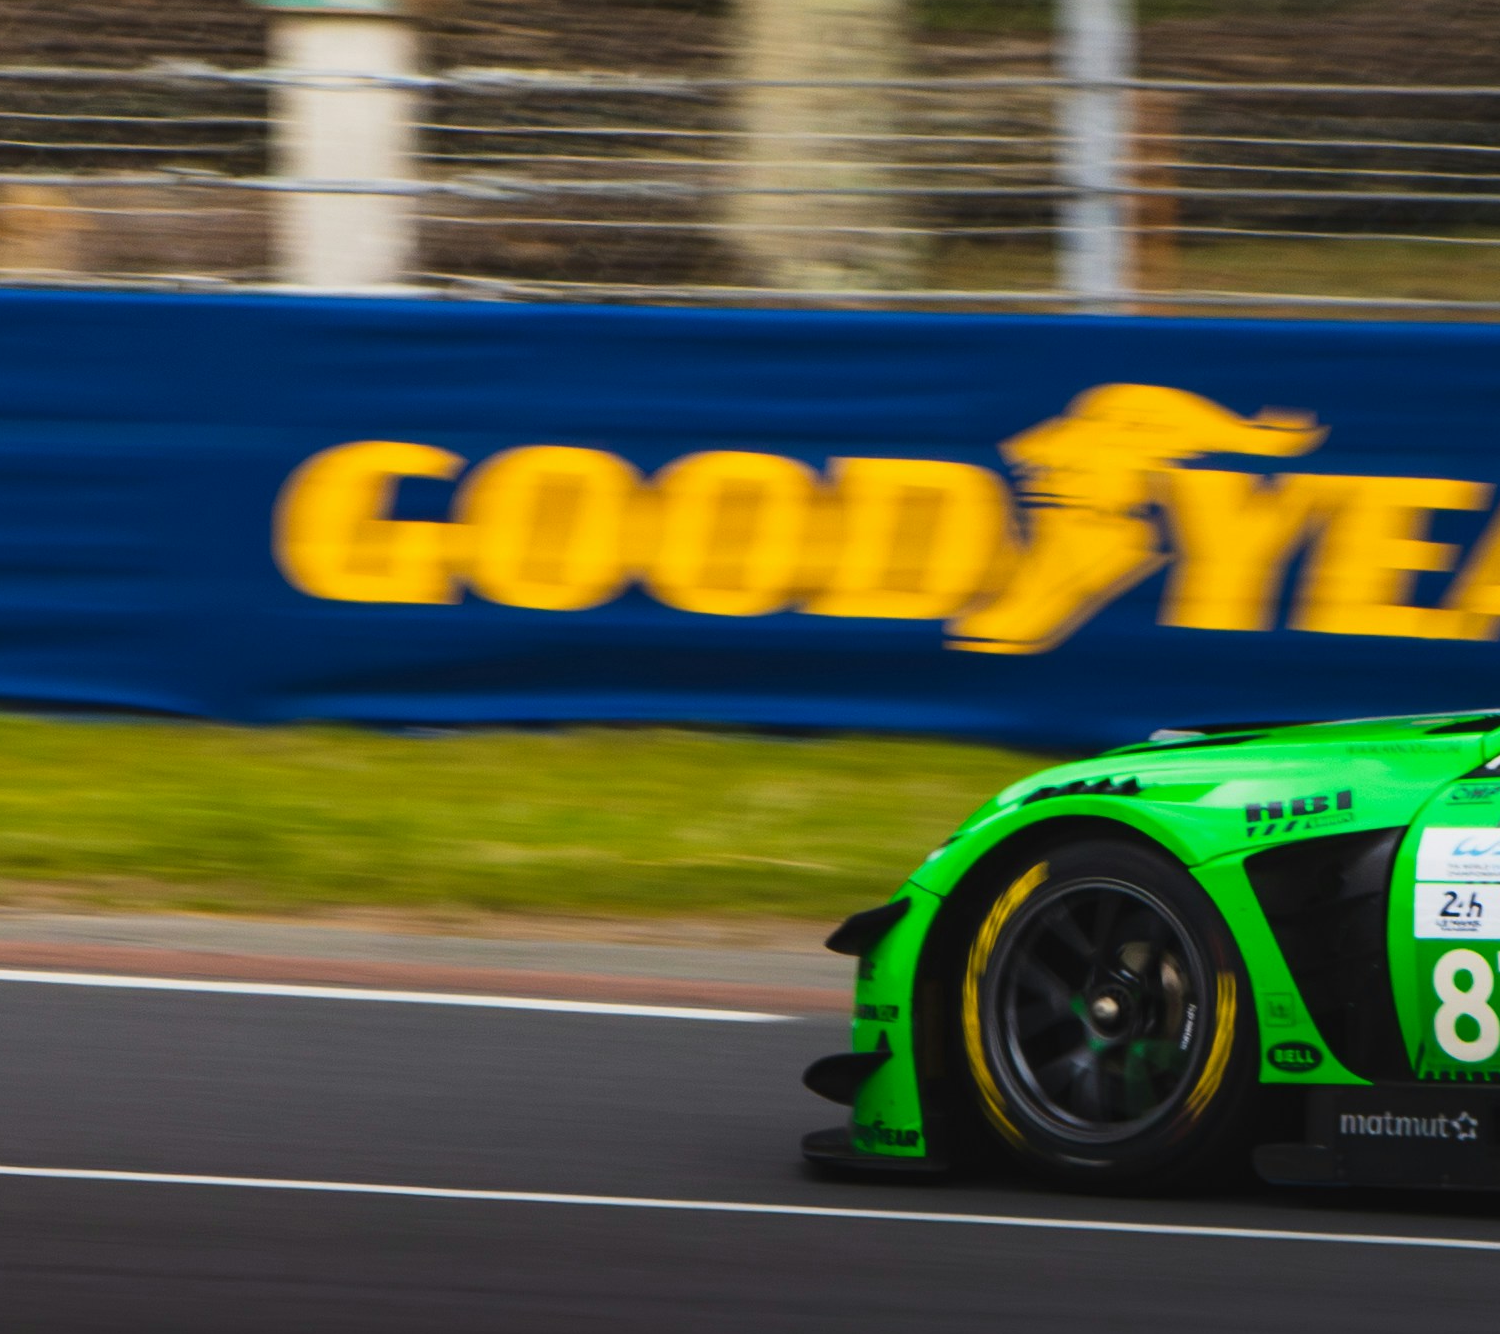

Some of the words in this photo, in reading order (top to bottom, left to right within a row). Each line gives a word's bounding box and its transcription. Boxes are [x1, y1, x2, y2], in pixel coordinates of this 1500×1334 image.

[1245, 789, 1353, 823] HBI
[1273, 1048, 1316, 1064] BELL
[1340, 1111, 1450, 1138] matmut
